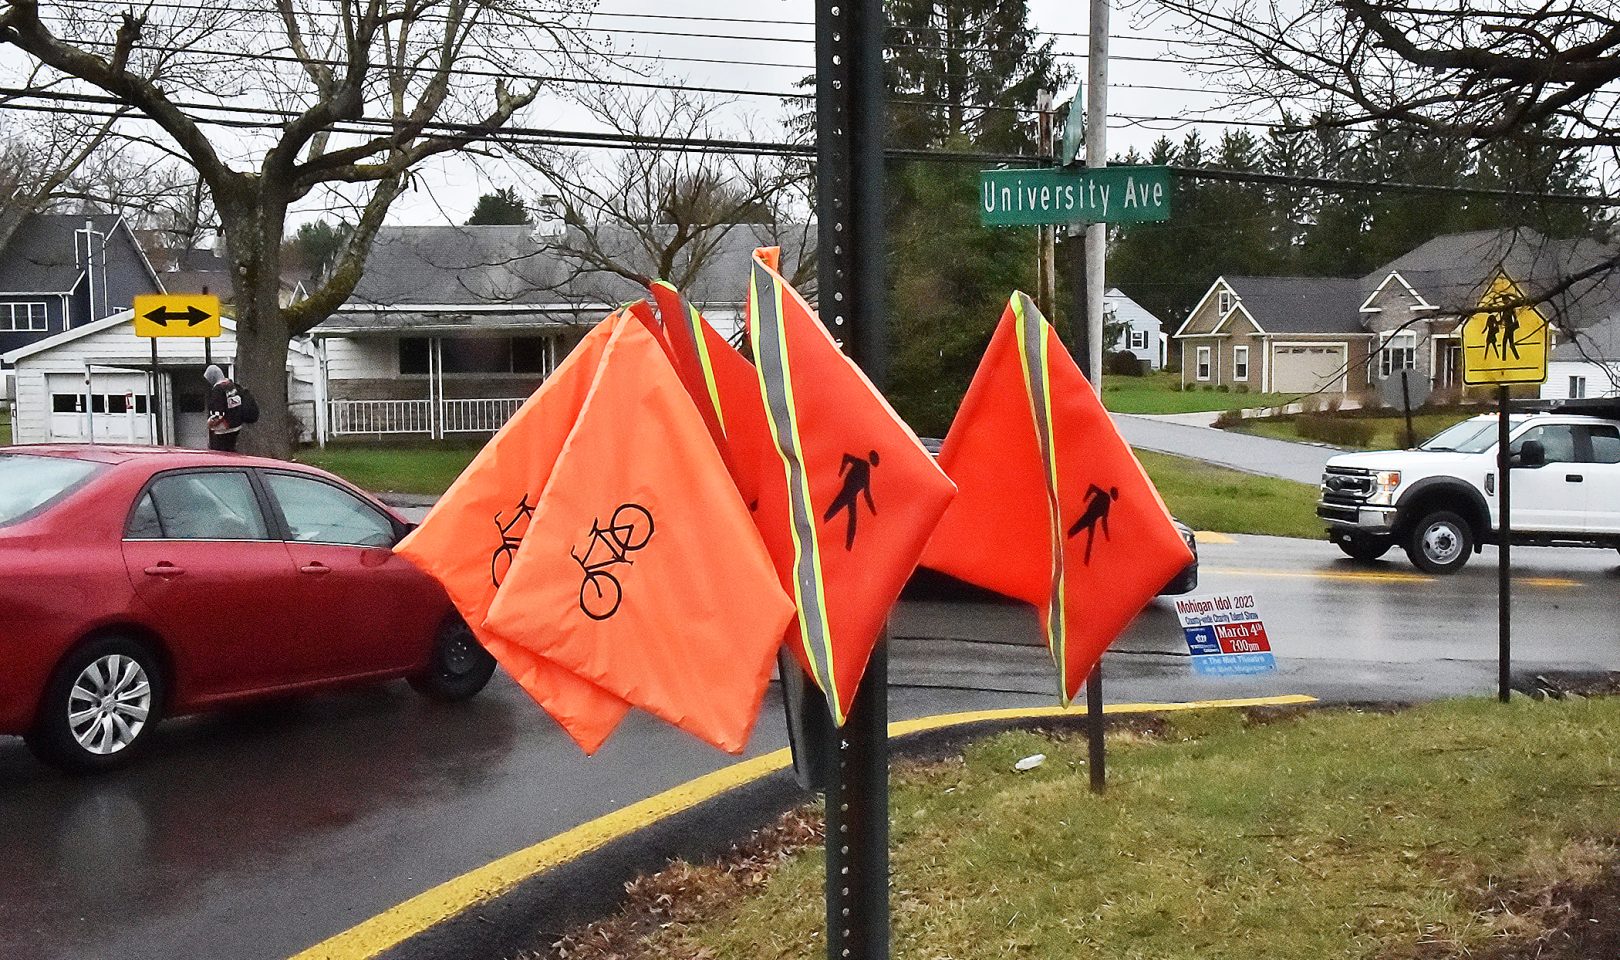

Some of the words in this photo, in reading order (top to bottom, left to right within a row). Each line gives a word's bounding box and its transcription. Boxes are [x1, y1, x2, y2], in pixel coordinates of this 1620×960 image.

[984, 178, 1110, 216] University
[1124, 176, 1163, 209] Ave
[1176, 599, 1214, 615] Mohigan
[1214, 596, 1232, 610] Idol
[1234, 595, 1254, 609] 2023
[1217, 624, 1249, 638] March
